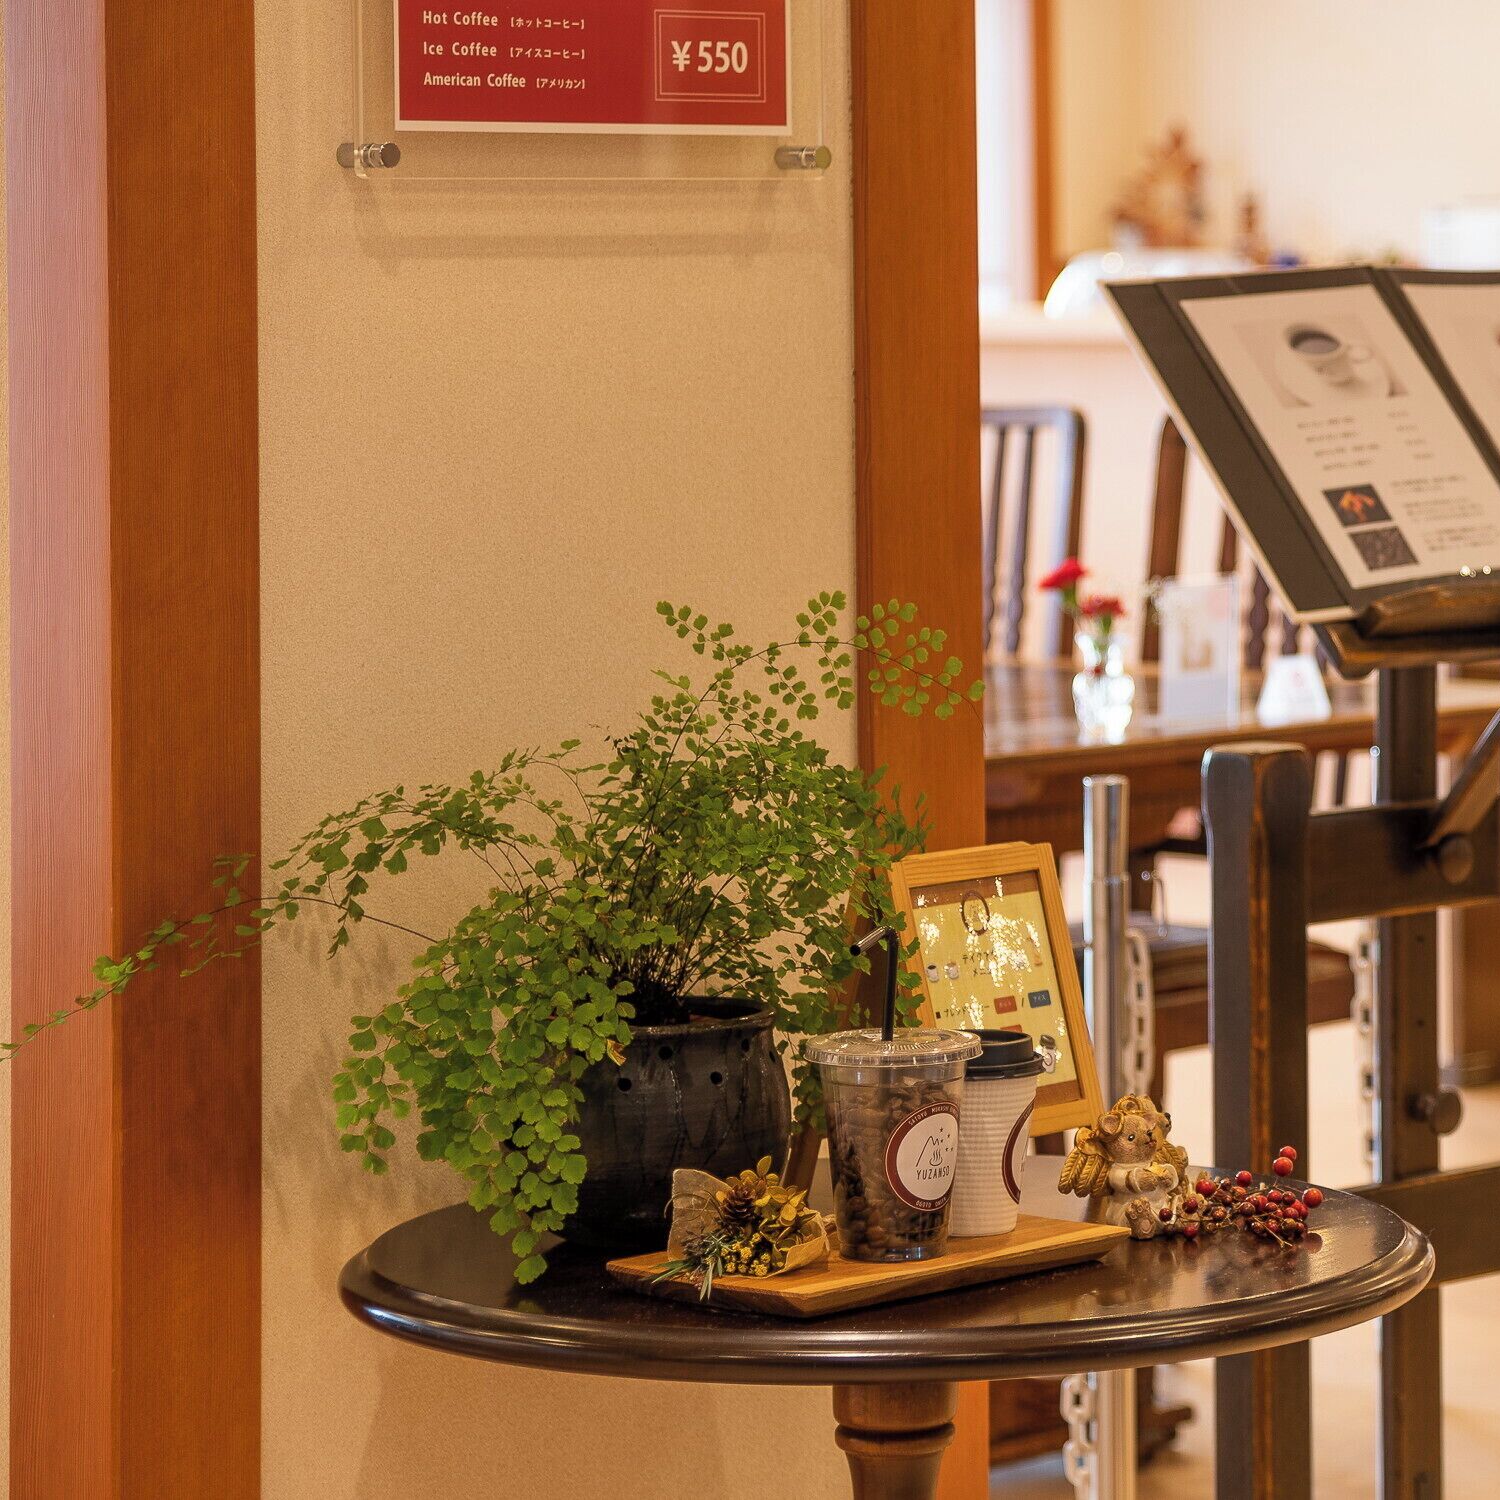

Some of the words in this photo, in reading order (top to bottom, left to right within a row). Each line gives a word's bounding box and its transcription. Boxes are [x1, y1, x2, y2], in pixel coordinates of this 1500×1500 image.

[423, 10, 447, 25] Hot
[453, 11, 498, 26] Coffee
[423, 41, 443, 55] Ice
[452, 42, 497, 57] Coffee
[423, 72, 481, 87] American
[487, 73, 526, 88] Coffee
[916, 1165, 950, 1181] YUZANSO
